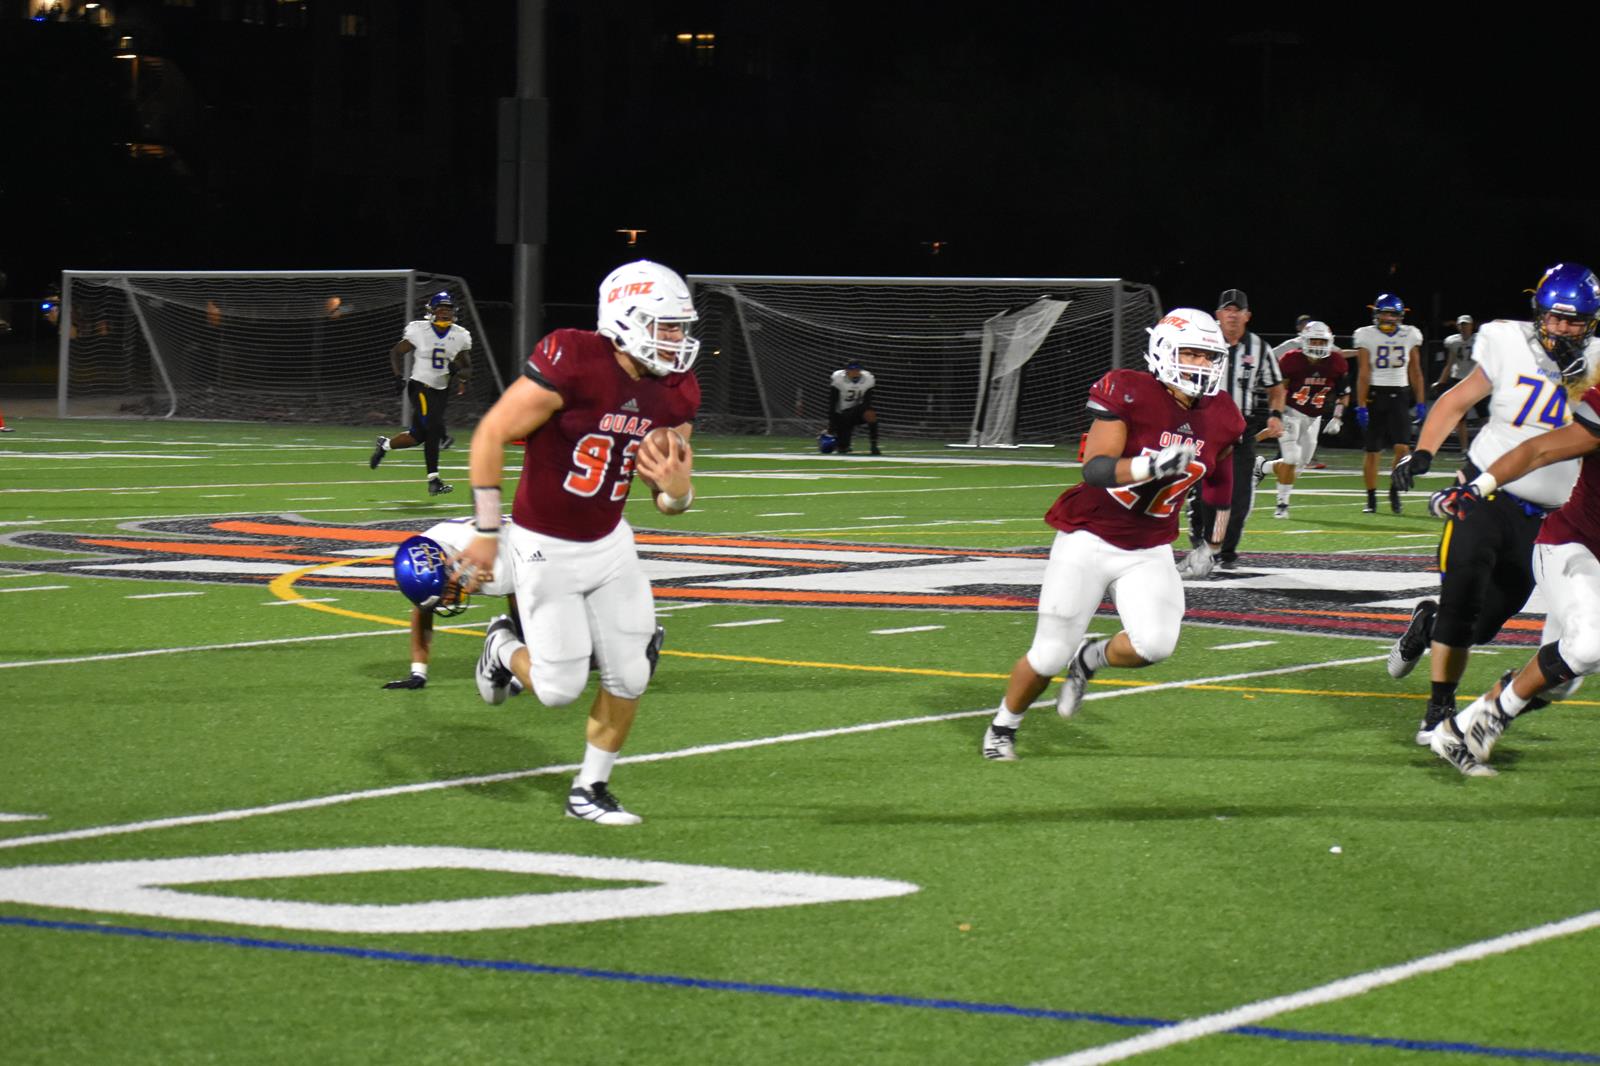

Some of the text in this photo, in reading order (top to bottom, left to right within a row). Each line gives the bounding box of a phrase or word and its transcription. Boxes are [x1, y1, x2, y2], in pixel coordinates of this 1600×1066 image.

[432, 347, 446, 369] 6
[1375, 345, 1405, 368] 83
[1511, 374, 1572, 430] 74
[599, 413, 653, 437] OUAZ
